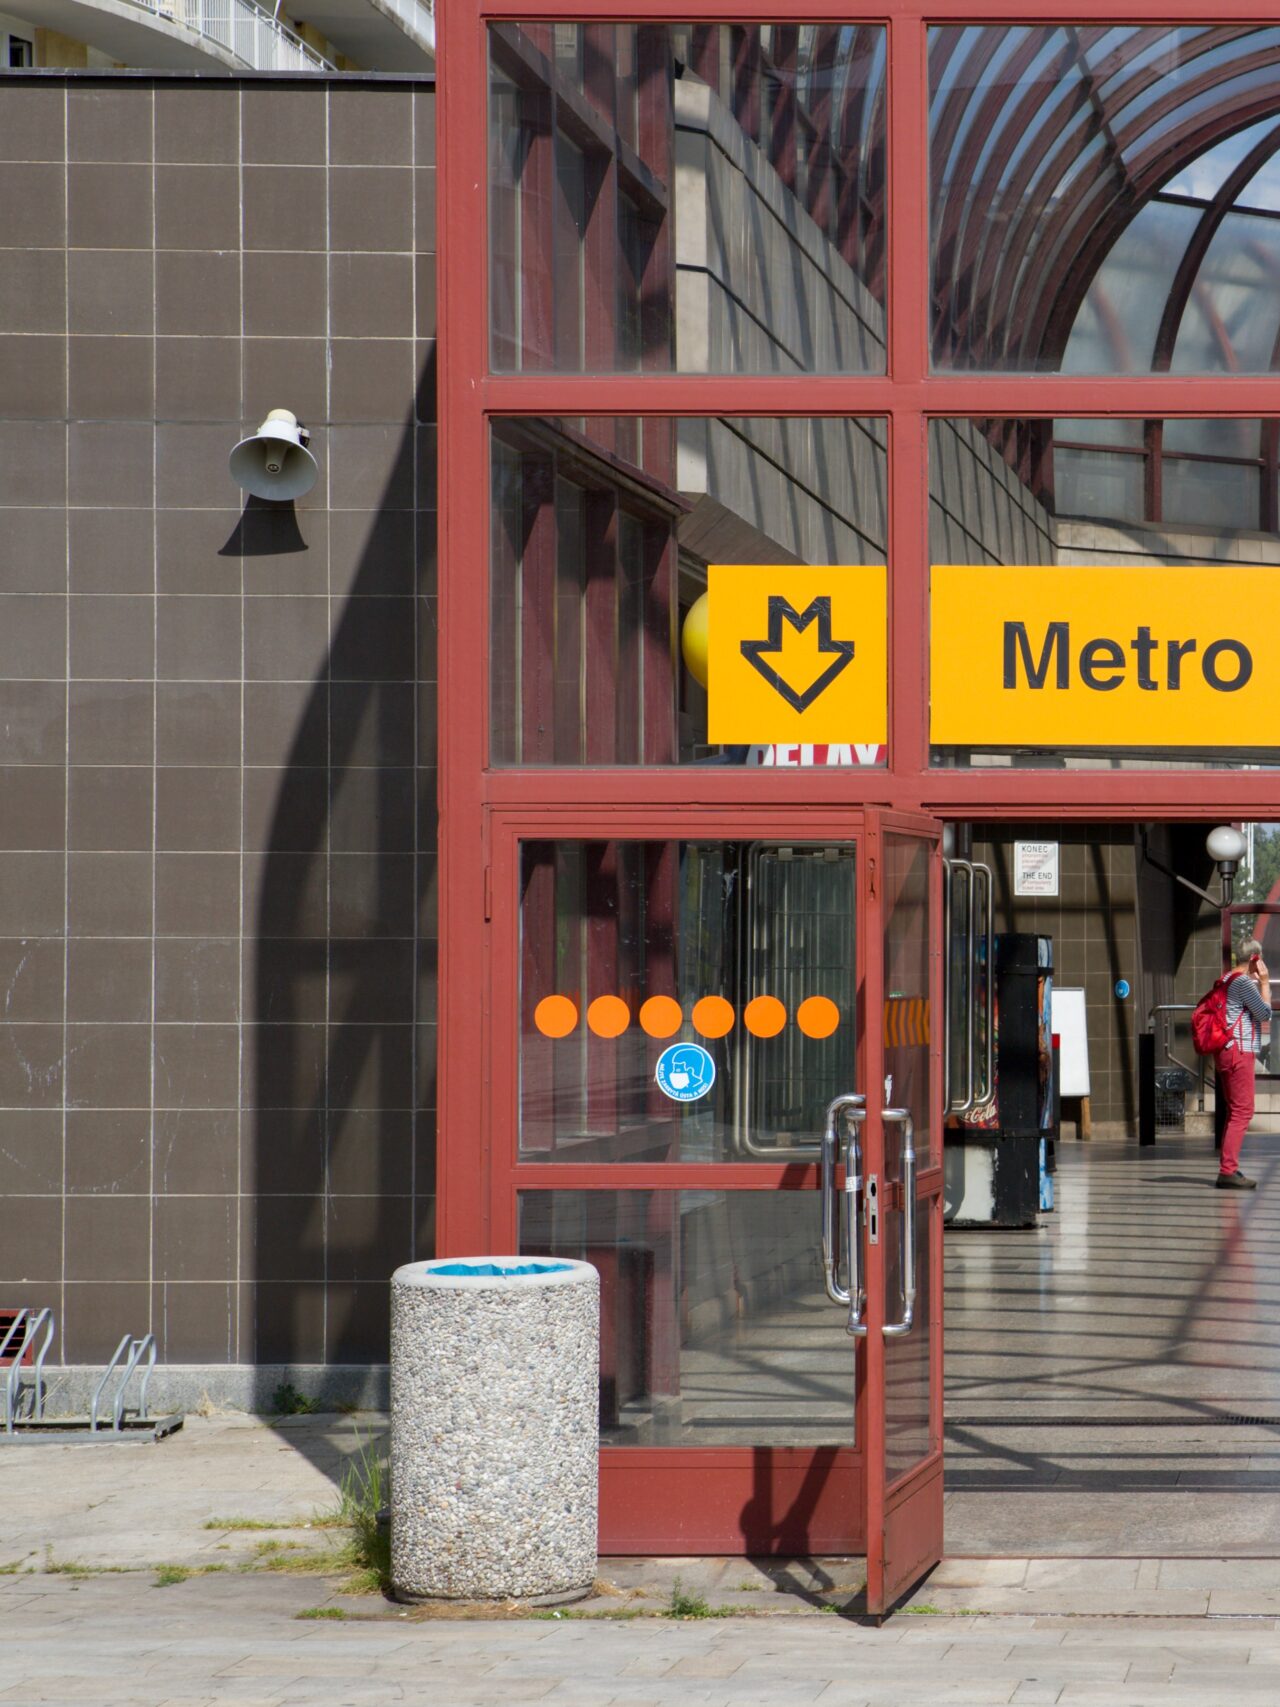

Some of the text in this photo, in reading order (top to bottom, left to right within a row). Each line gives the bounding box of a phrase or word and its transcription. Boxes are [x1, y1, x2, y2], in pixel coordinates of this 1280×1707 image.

[1003, 621, 1253, 692] Metro
[1022, 845, 1047, 853] KONEC
[1022, 872, 1053, 880] THE END
